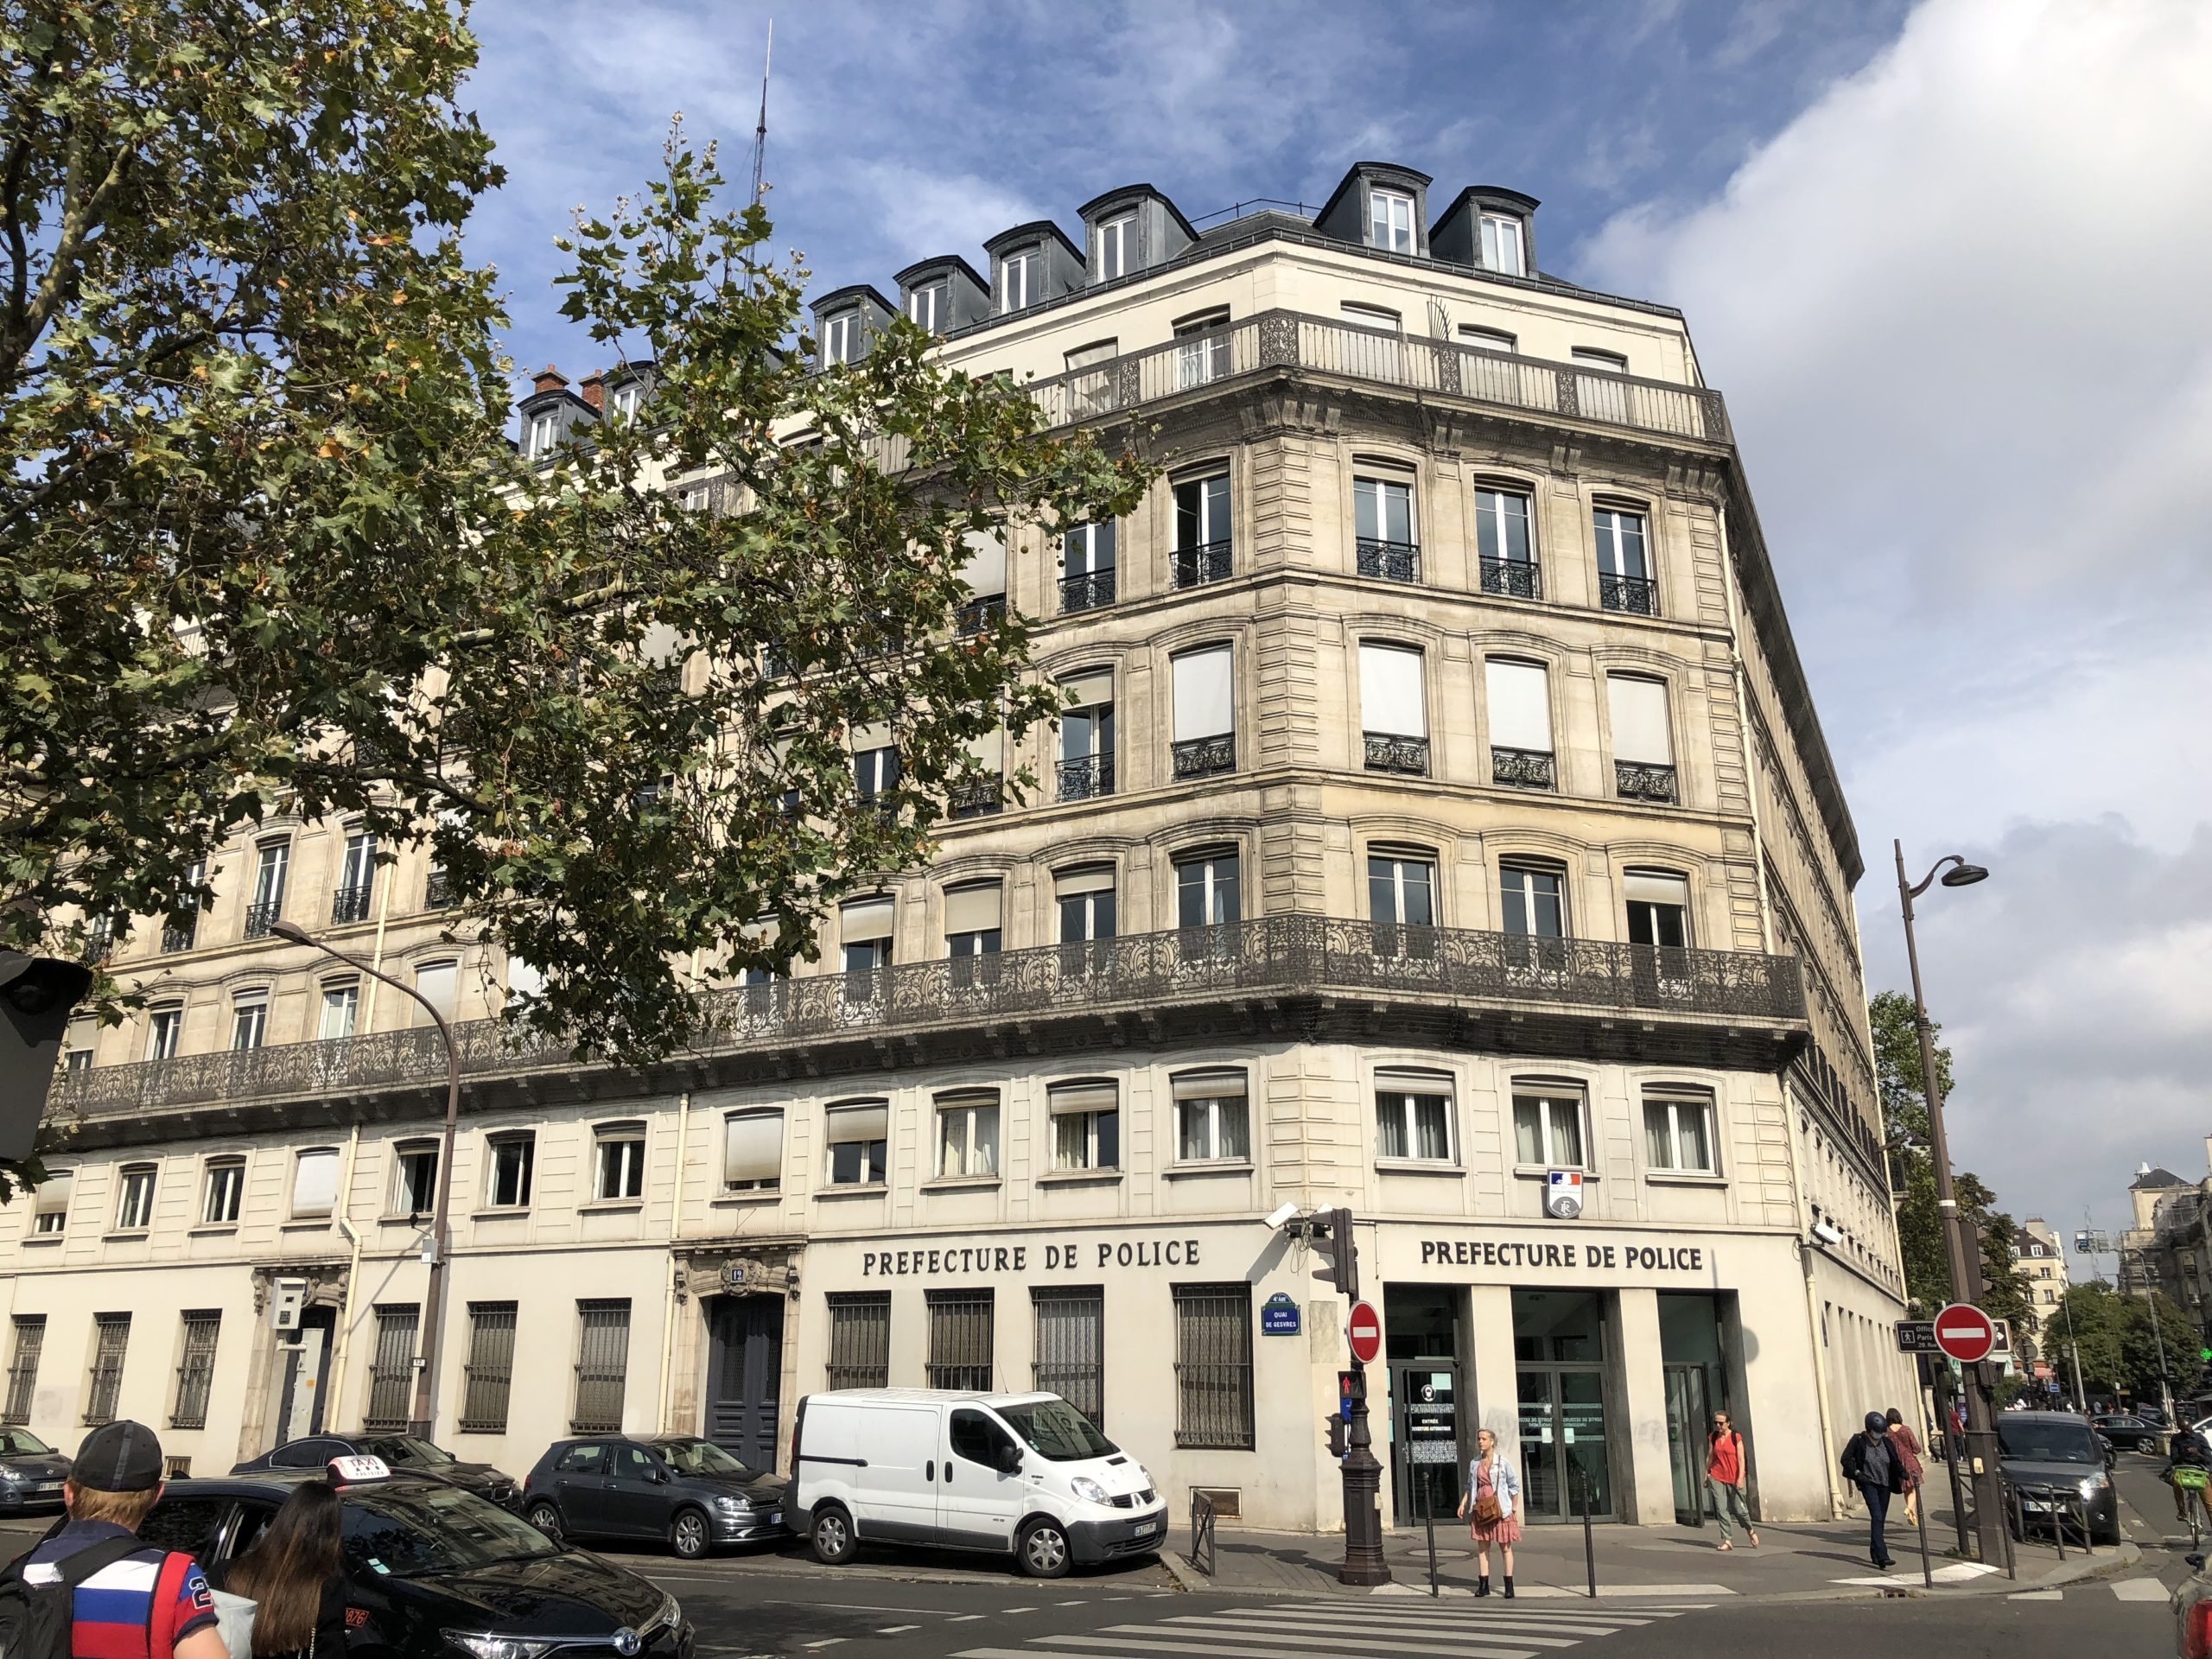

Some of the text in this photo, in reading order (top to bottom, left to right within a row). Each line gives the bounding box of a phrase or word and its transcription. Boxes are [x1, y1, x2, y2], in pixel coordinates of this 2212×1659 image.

[862, 1240, 1200, 1275] PREFECTURE DE POLICE
[1421, 1241, 1702, 1270] PREFECTURE DE POLICE
[734, 1269, 742, 1280] 12
[347, 1458, 378, 1467] TAXI
[188, 1576, 213, 1610] 2
[346, 1608, 365, 1624] 876
